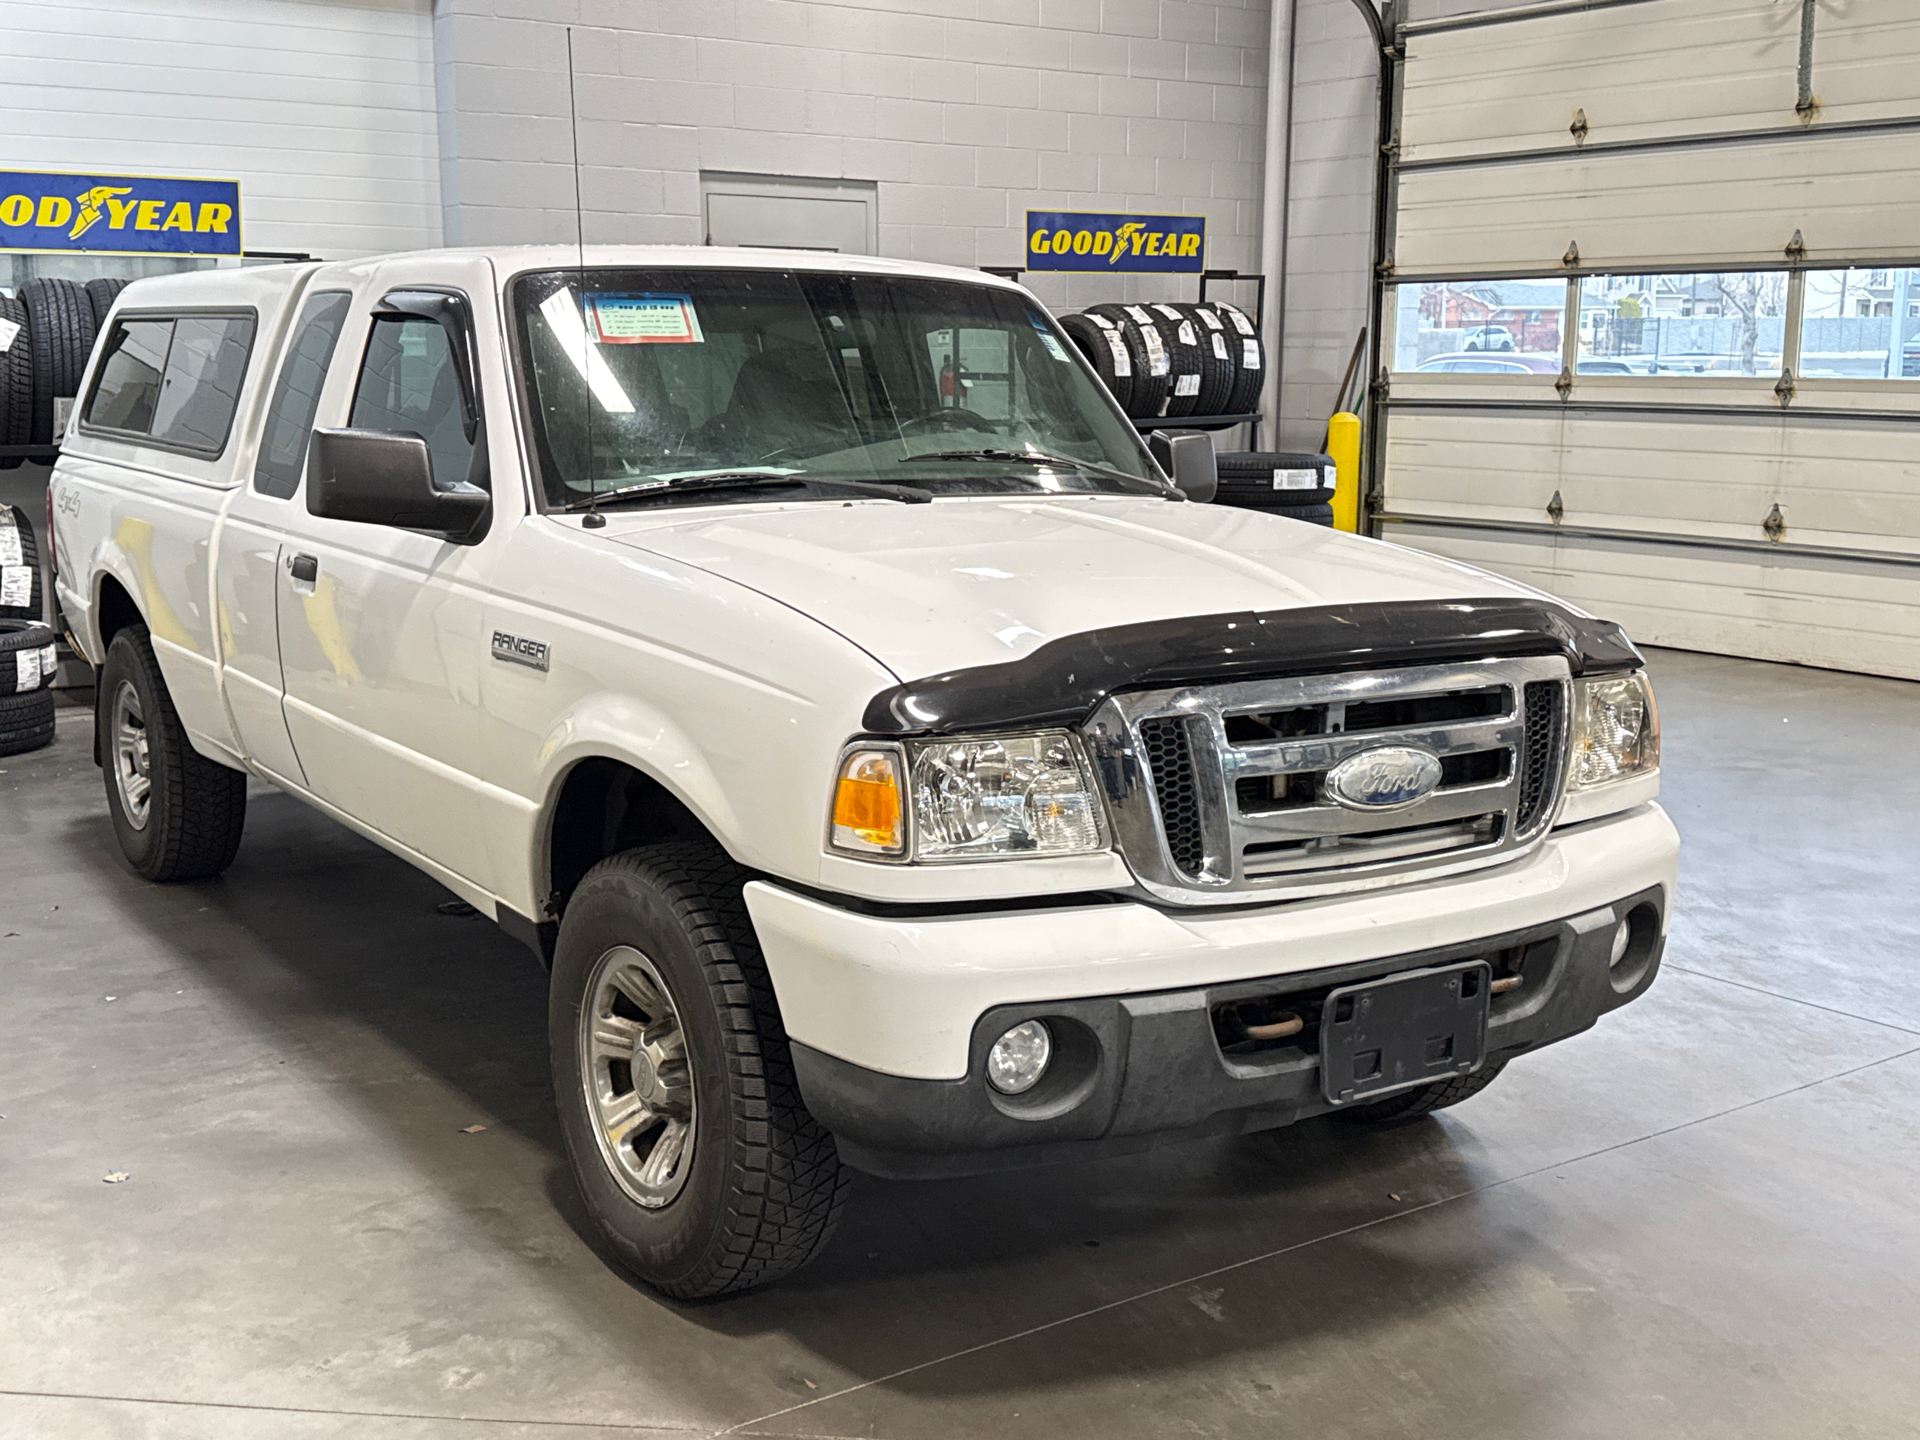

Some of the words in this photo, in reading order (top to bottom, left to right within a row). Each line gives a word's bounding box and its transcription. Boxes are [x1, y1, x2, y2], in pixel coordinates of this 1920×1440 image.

[105, 198, 232, 233] YEAR
[492, 631, 546, 659] RANGER
[1361, 759, 1425, 796] Ford
